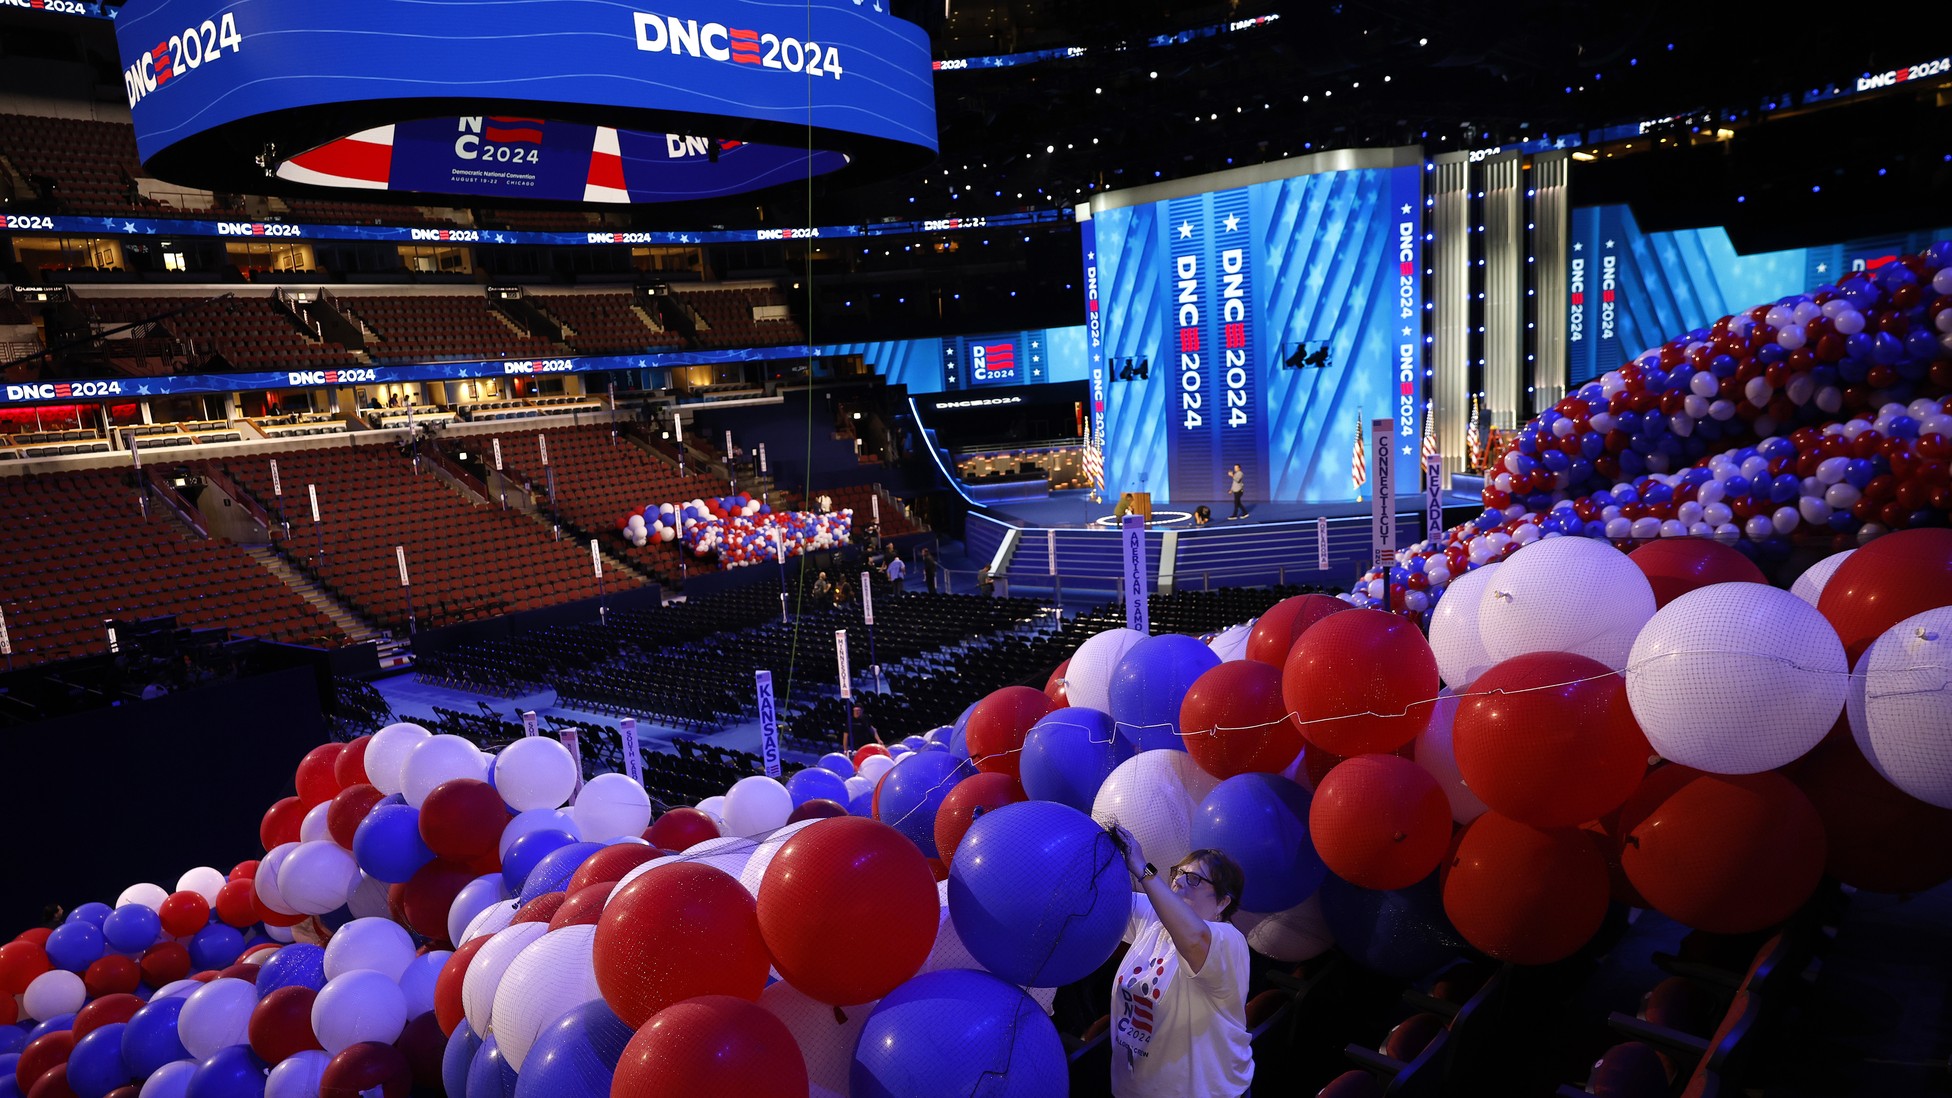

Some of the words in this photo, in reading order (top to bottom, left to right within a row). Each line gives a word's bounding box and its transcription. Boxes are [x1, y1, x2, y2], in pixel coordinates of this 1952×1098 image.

[0, 0, 31, 8] NC
[168, 12, 242, 77] 2024
[633, 11, 727, 62] DNC
[760, 33, 843, 81] 2024
[452, 168, 483, 177] Democratic
[483, 170, 506, 178] National
[506, 172, 536, 180] Convention
[482, 145, 539, 164] 2024
[1177, 255, 1199, 327] DNC
[1222, 249, 1245, 322] DNC
[7, 383, 55, 400] DNC
[71, 380, 122, 398] 2024
[987, 369, 1015, 379] 2024
[1181, 353, 1203, 430] 2024
[1226, 350, 1247, 428] 2024
[1378, 436, 1390, 546] CONNECTICUT
[1428, 464, 1441, 532] NEVADA
[1130, 532, 1141, 595] AMERICAN
[1319, 523, 1327, 563] OKLAHOMA
[838, 639, 848, 689] MINNESOTA
[626, 730, 635, 758] SOUTH
[759, 684, 777, 763] KANSAS
[1126, 1027, 1152, 1044] 2024
